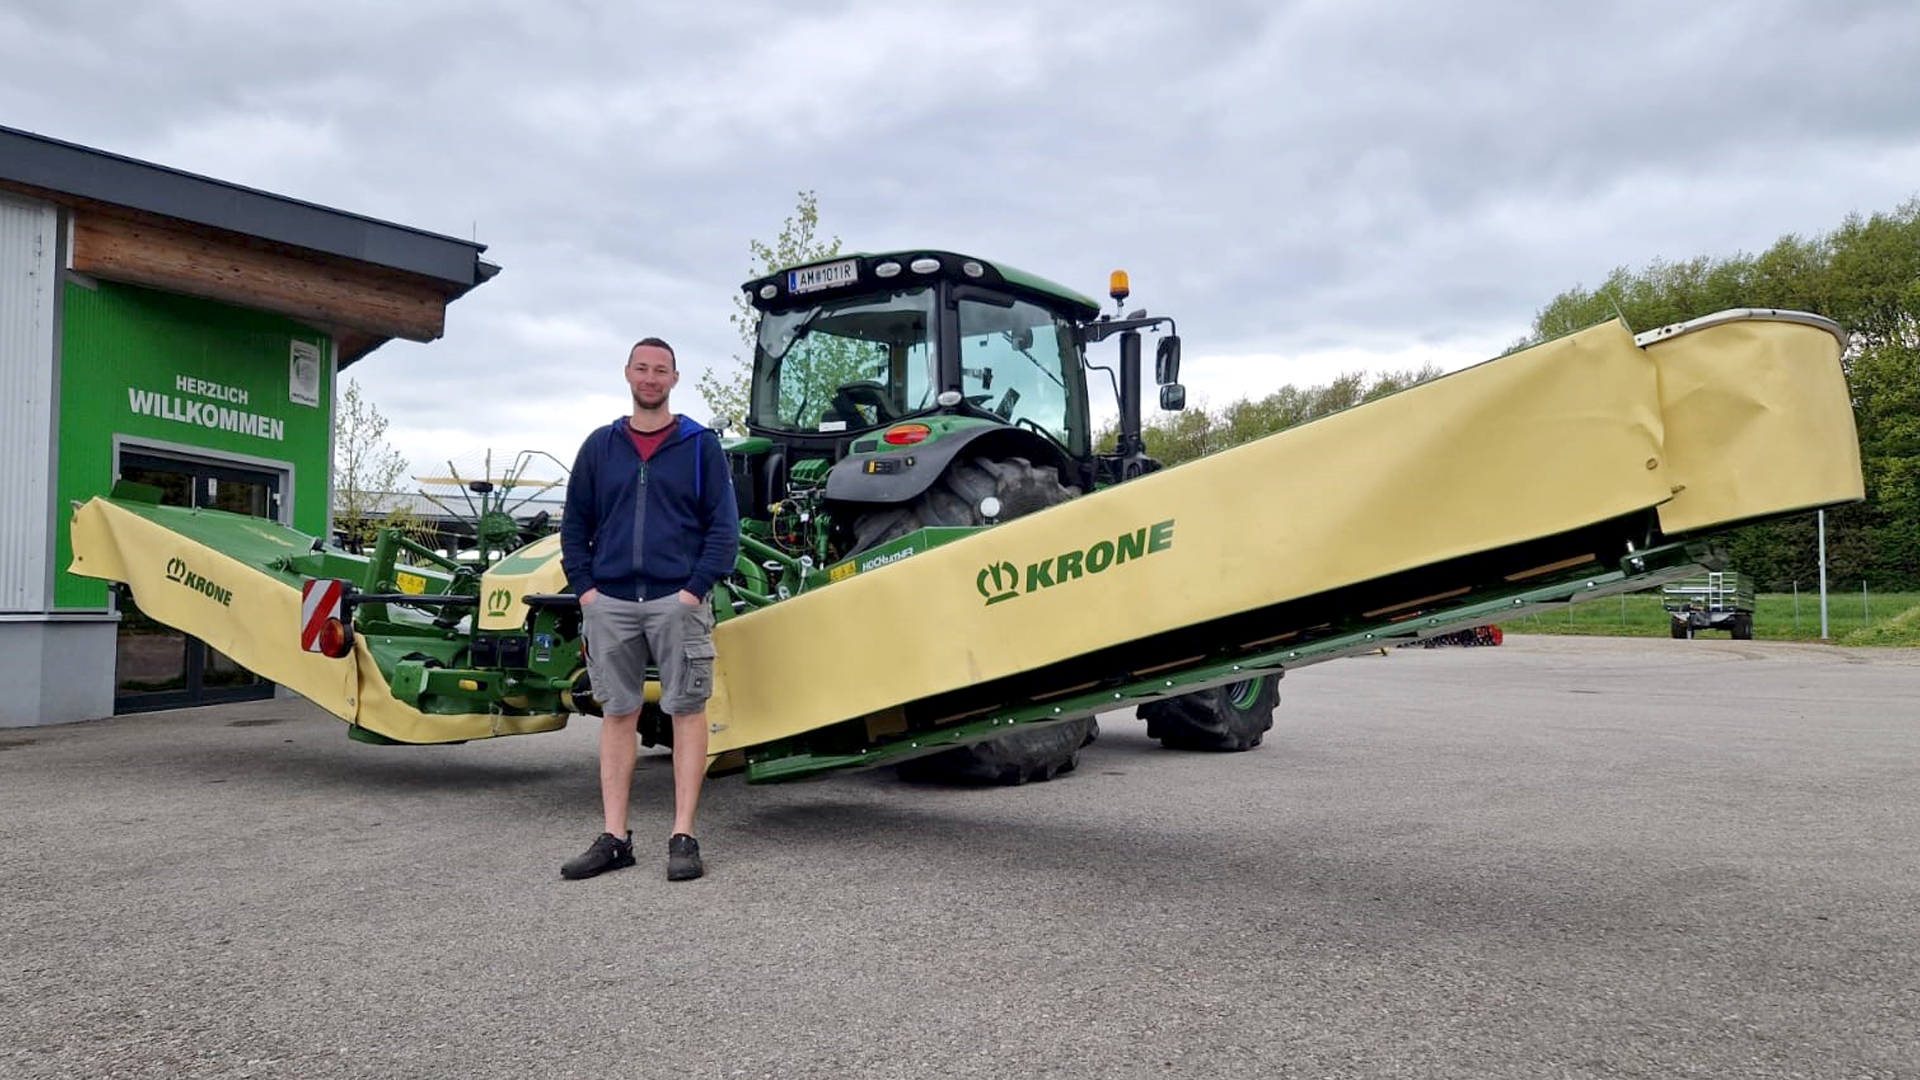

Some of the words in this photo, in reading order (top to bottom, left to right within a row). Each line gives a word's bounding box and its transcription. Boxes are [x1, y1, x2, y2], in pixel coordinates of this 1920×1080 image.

[801, 270, 814, 286] AM
[176, 374, 249, 404] HERZLICH
[128, 388, 284, 441] WILLKOMMEN
[1026, 519, 1175, 593] KRONE
[184, 571, 233, 607] KRONE
